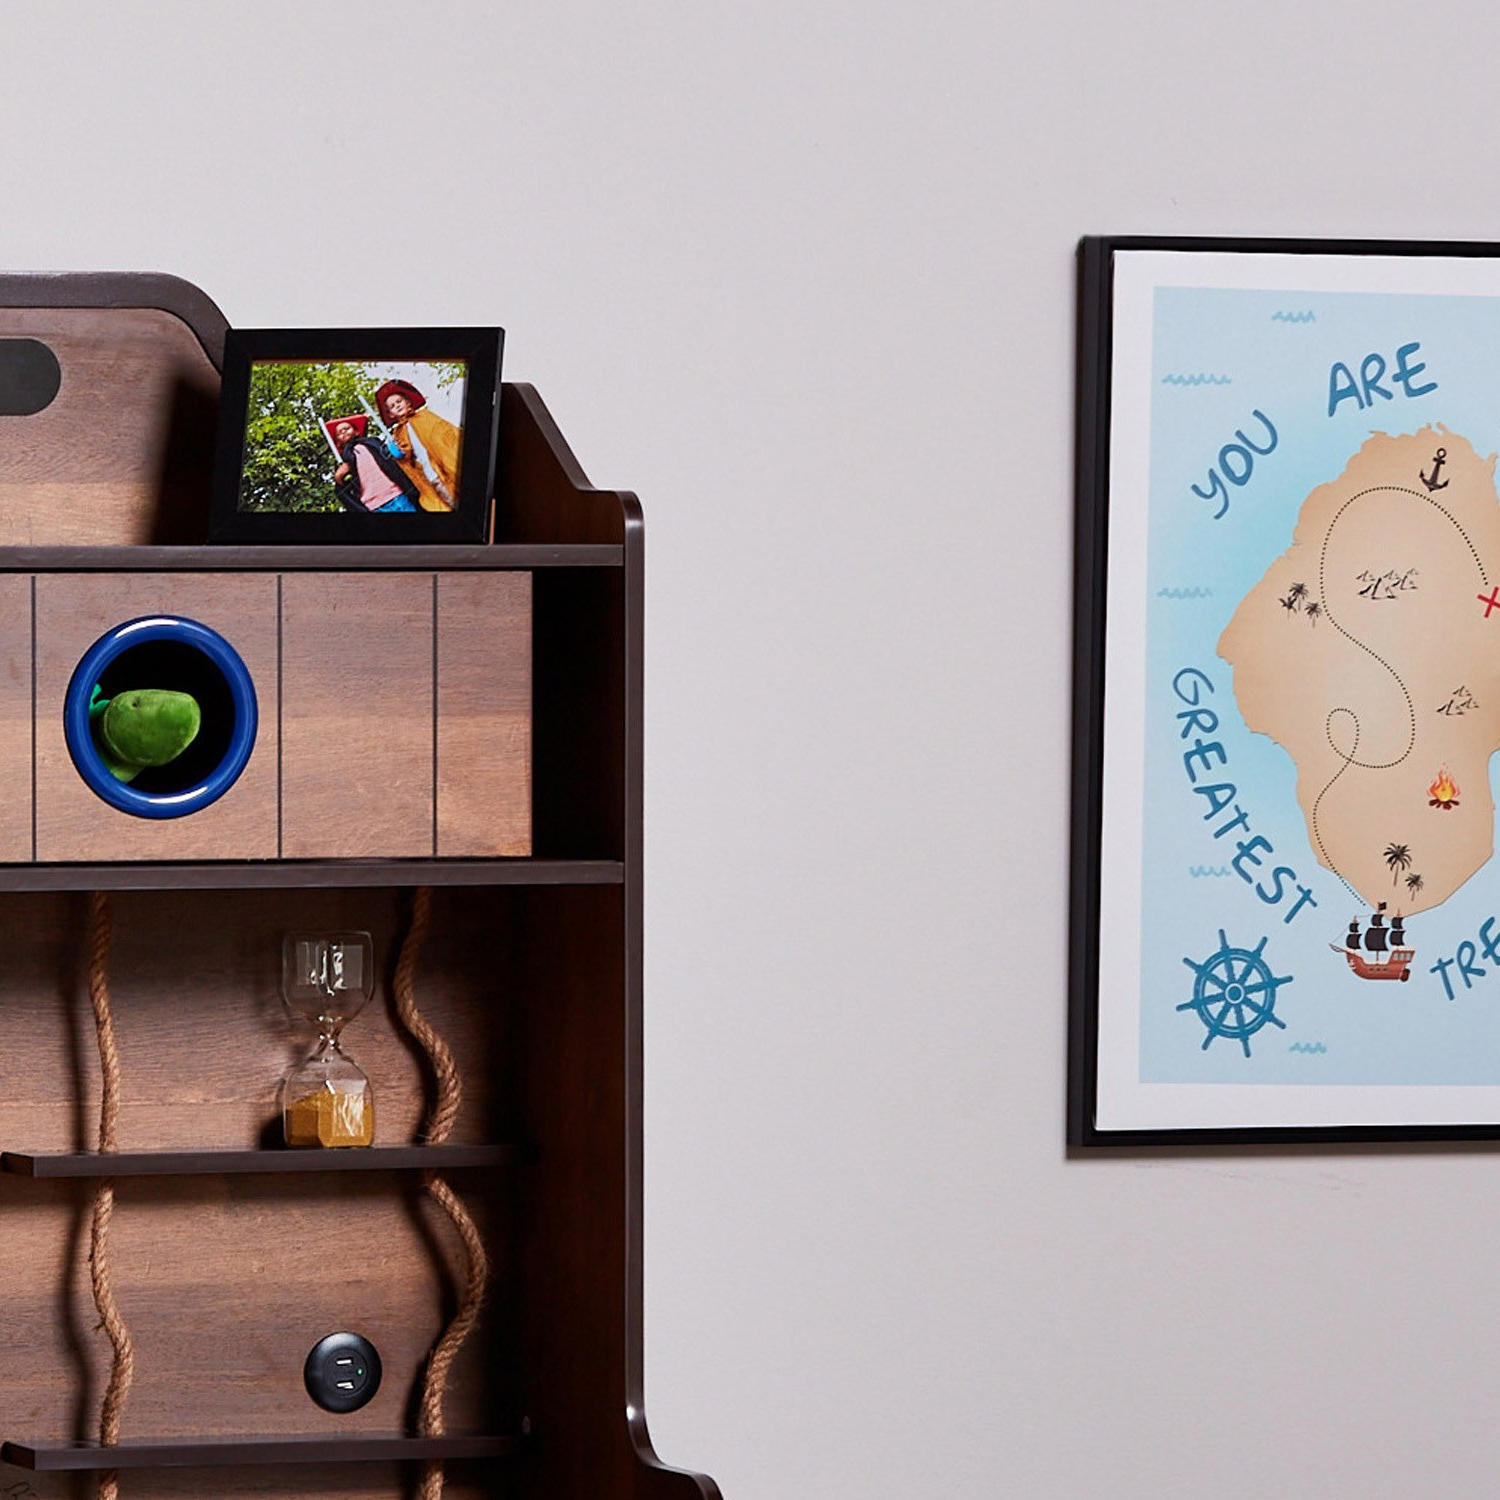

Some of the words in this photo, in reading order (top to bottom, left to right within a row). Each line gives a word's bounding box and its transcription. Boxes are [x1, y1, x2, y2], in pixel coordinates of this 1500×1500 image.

[1190, 409, 1279, 521] YOU
[1327, 342, 1439, 418] ARE
[1172, 667, 1318, 925] GREATEST
